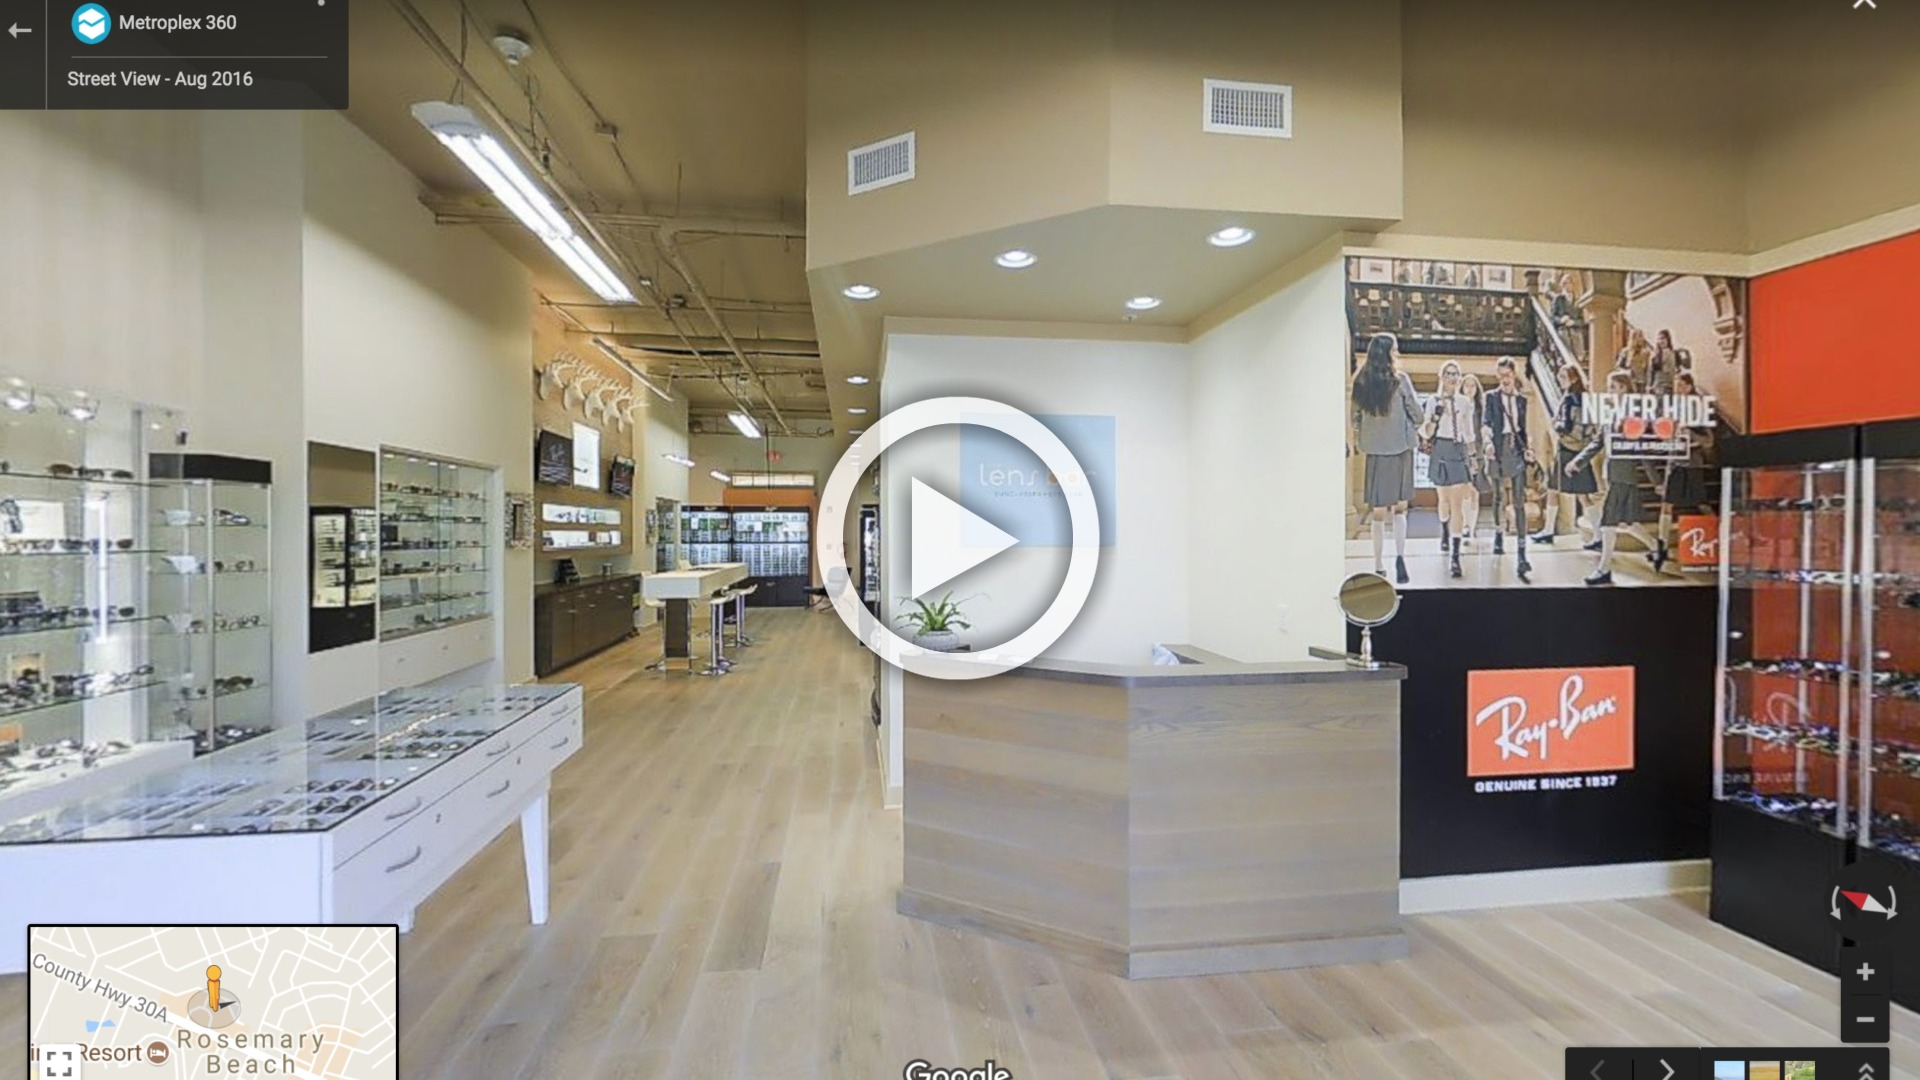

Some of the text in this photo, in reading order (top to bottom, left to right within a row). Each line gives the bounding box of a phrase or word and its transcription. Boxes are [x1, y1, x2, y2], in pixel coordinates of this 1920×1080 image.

[1581, 392, 1717, 427] NEVER HIDE
[979, 463, 1039, 487] lens
[1474, 775, 1618, 793] GENUINE SINCE 1937
